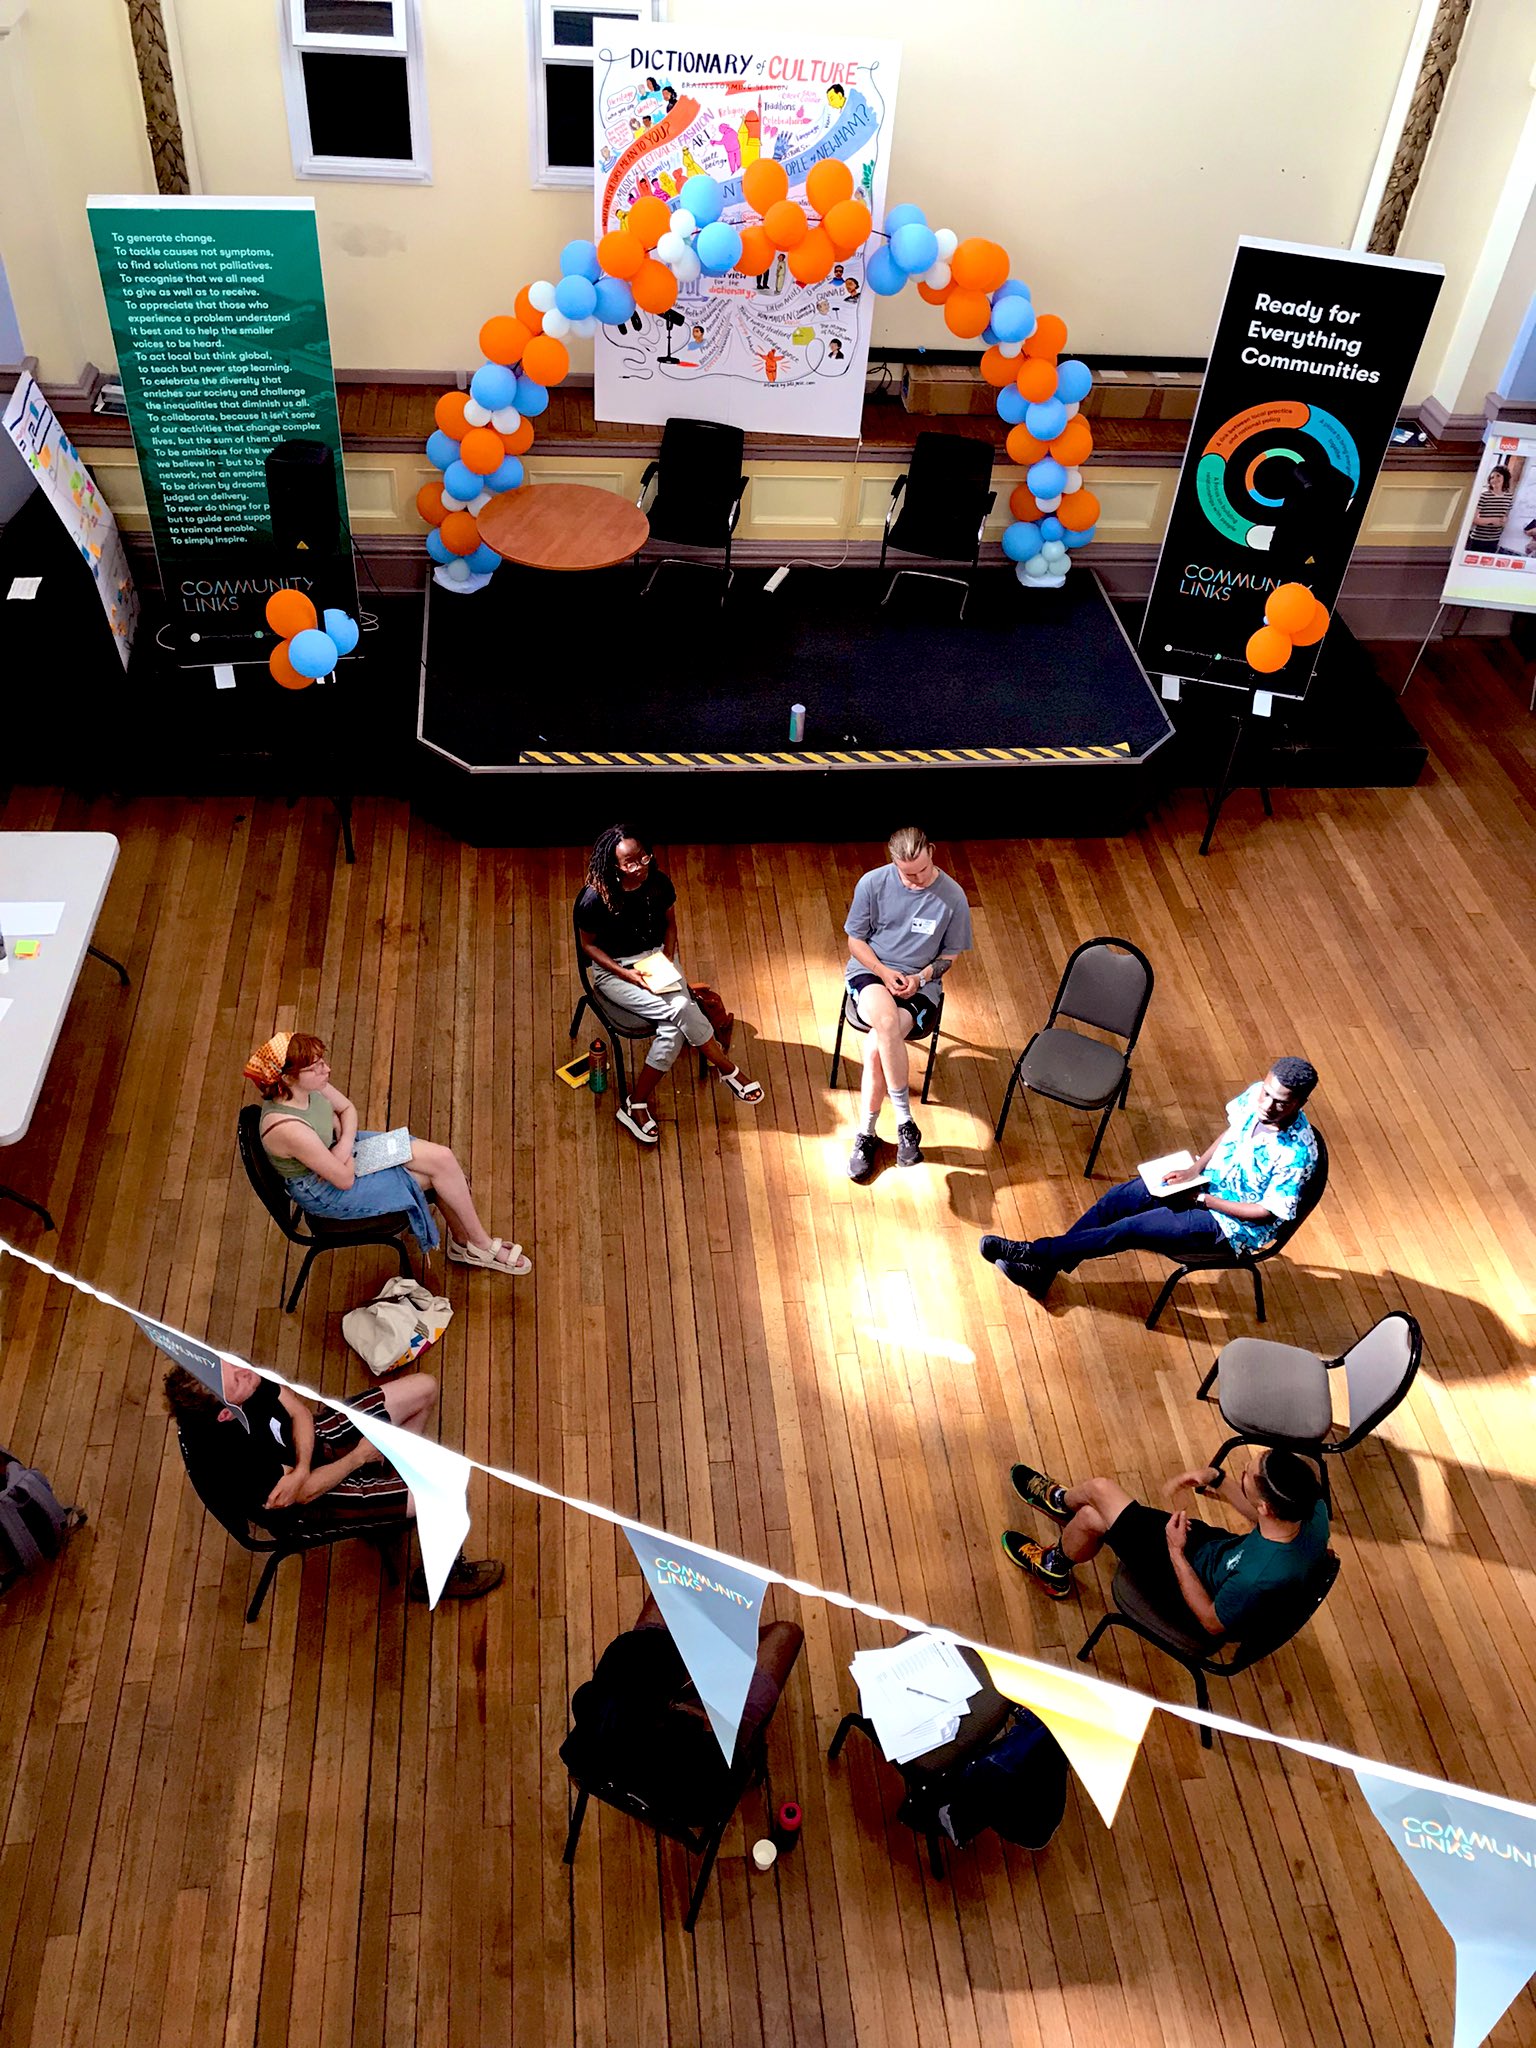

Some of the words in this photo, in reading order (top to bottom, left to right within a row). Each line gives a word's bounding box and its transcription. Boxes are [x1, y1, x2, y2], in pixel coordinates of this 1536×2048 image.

[630, 48, 753, 75] DICTIONARY
[756, 56, 766, 75] of
[768, 55, 859, 85] CULTURE
[785, 156, 808, 177] OPLE
[816, 103, 870, 160] NEWHAM?
[127, 233, 173, 244] generate
[175, 233, 216, 245] change.
[129, 247, 161, 256] tackle
[201, 247, 218, 256] not
[130, 260, 151, 270] find
[153, 260, 199, 270] solutions
[201, 260, 218, 270] not
[220, 260, 273, 272] palliatives.
[134, 274, 183, 285] recognise
[185, 274, 207, 283] that
[225, 274, 238, 283] all
[240, 274, 265, 283] need
[136, 287, 157, 298] give
[173, 287, 193, 296] well
[222, 287, 260, 297] receive.
[140, 300, 194, 311] appreciate
[195, 300, 217, 309] that
[219, 300, 246, 309] those
[248, 300, 269, 309] who
[1254, 293, 1323, 324] Ready
[1328, 304, 1361, 325] for
[128, 313, 182, 325] experience
[193, 313, 234, 324] problem
[235, 312, 291, 322] understand
[140, 326, 162, 336] best
[164, 326, 183, 336] and
[198, 326, 219, 337] help
[221, 326, 237, 336] the
[239, 326, 274, 335] smaller
[133, 339, 164, 349] voices
[193, 339, 225, 348] heard.
[1247, 320, 1362, 358] Everything
[149, 352, 166, 361] act
[167, 352, 192, 361] local
[193, 351, 211, 361] but
[212, 351, 237, 361] think
[150, 364, 179, 374] teach
[181, 364, 198, 374] but
[200, 365, 226, 373] never
[228, 363, 249, 375] stop
[250, 363, 293, 374] learning.
[1240, 347, 1381, 384] Communities
[154, 376, 200, 386] celebrate
[202, 376, 217, 385] the
[220, 375, 260, 387] diversity
[262, 375, 282, 384] that
[143, 388, 184, 398] enriches
[186, 389, 202, 397] our
[204, 387, 238, 399] society
[240, 387, 259, 397] and
[260, 386, 306, 398] challenge
[145, 401, 162, 411] the
[163, 400, 218, 412] inequalities
[220, 399, 240, 409] that
[242, 399, 281, 409] diminish
[295, 398, 310, 408] all.
[219, 411, 259, 421] because
[270, 410, 289, 420] isn't
[291, 411, 316, 420] some
[162, 426, 178, 434] our
[180, 423, 223, 434] activities
[224, 423, 245, 433] that
[246, 422, 281, 434] change
[282, 421, 321, 433] complex
[178, 435, 194, 445] but
[196, 435, 212, 445] the
[214, 436, 233, 444] sum
[247, 434, 270, 444] them
[272, 433, 287, 443] all.
[182, 446, 228, 457] ambitious
[229, 446, 243, 456] for
[245, 445, 260, 455] the
[172, 459, 205, 469] believe
[226, 458, 242, 468] but
[201, 469, 217, 479] not
[233, 468, 266, 480] empire.
[188, 481, 217, 490] driven
[232, 479, 266, 489] dreams
[163, 492, 195, 504] judged
[211, 491, 249, 503] delivery.
[178, 504, 203, 512] never
[219, 501, 247, 513] things
[249, 501, 261, 511] for
[167, 514, 184, 524] but
[197, 513, 222, 525] guide
[224, 513, 242, 522] and
[181, 524, 203, 534] train
[204, 524, 222, 533] and
[224, 523, 257, 533] enable.
[184, 535, 214, 546] simply
[215, 534, 248, 546] inspire.
[1184, 564, 1313, 592] COMMUN
[180, 577, 314, 596] COMMUNITY
[1179, 579, 1231, 601] LINKS
[182, 596, 240, 612] LINKS
[655, 1557, 753, 1609] COMMUNITY
[657, 1569, 703, 1592] LINKS
[1402, 1817, 1536, 1869] COMMUNI
[1404, 1831, 1475, 1861] LINKS
